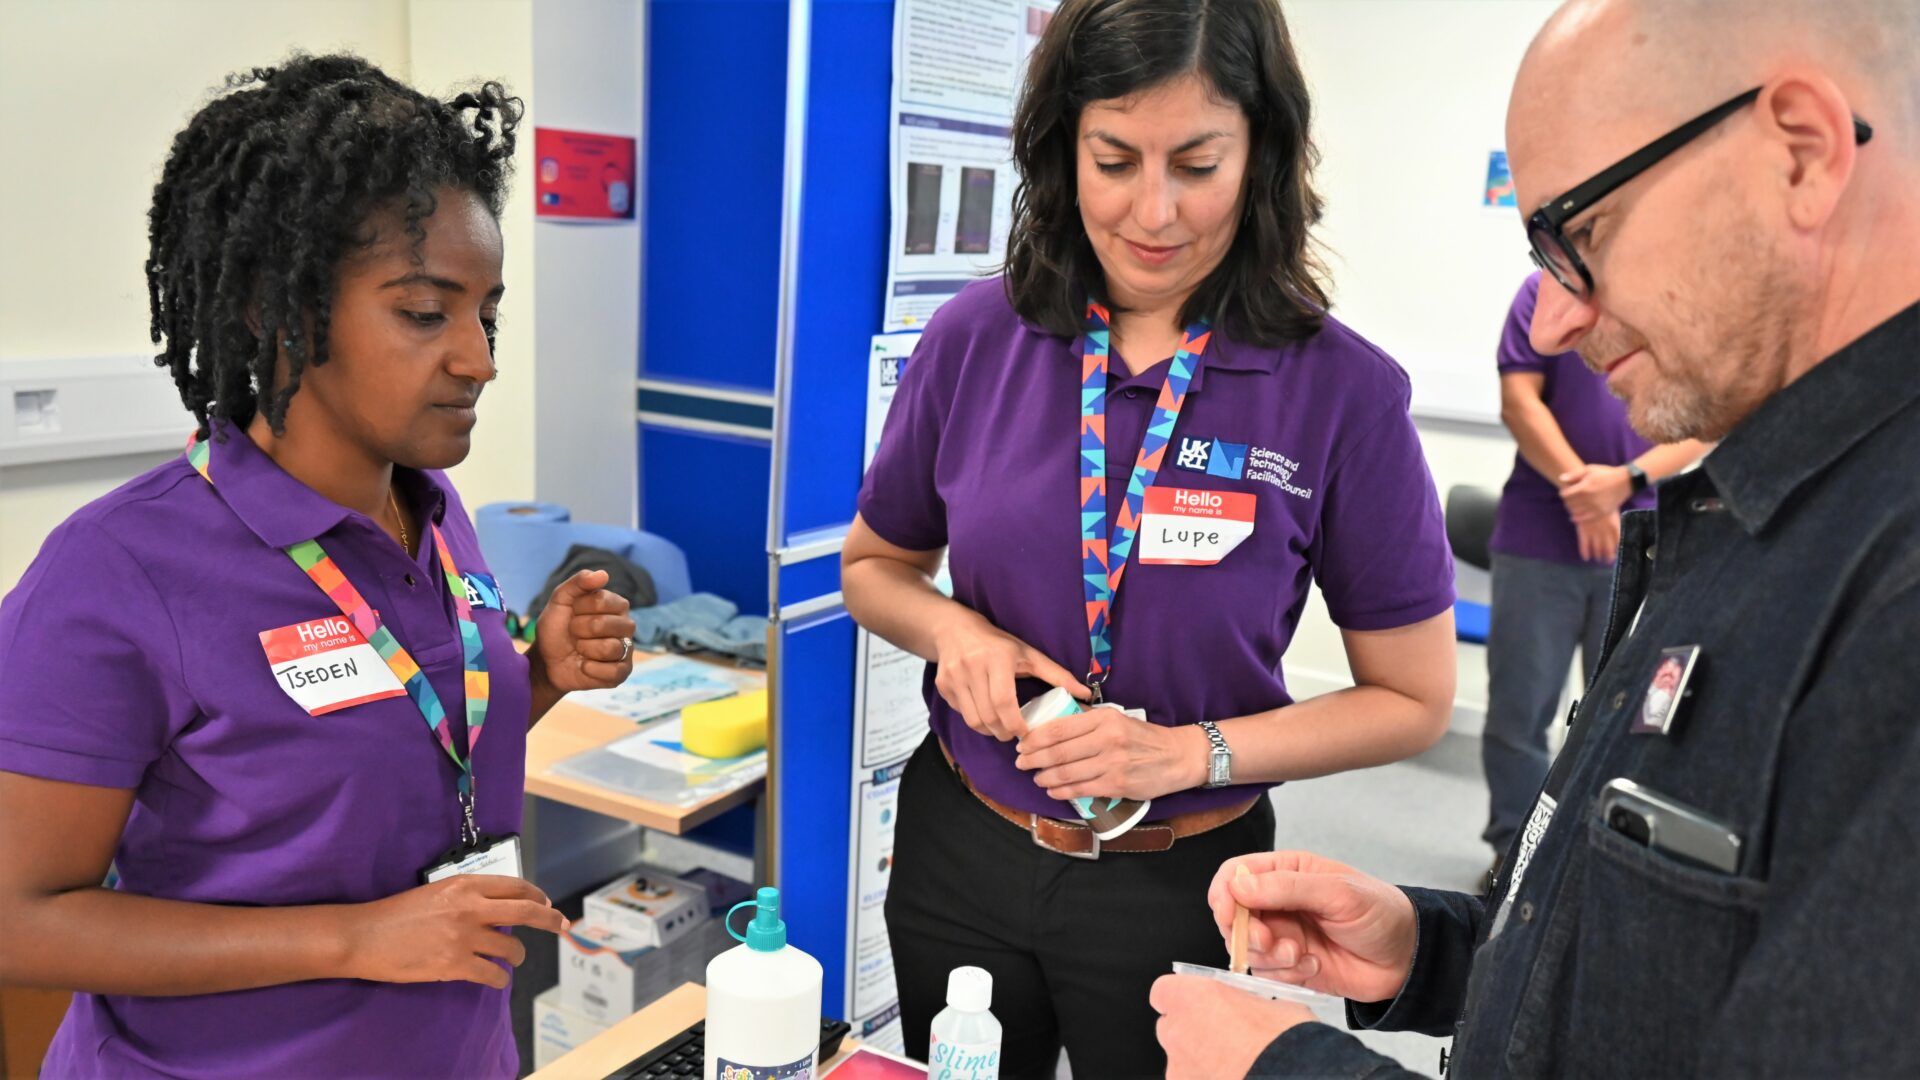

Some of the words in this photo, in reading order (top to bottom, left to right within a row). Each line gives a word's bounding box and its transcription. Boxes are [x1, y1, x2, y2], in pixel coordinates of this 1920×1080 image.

[1181, 438, 1211, 459] UK
[1176, 451, 1206, 470] RI
[1250, 446, 1285, 462] Science
[1283, 459, 1300, 472] and
[1175, 490, 1222, 507] Hello
[1280, 480, 1312, 499] Council
[1188, 507, 1214, 515] name
[296, 618, 350, 642] Hello
[303, 642, 319, 652] my
[320, 635, 348, 648] name
[349, 634, 357, 642] is
[276, 657, 358, 689] TSEDEN
[934, 1043, 998, 1070] Slime
